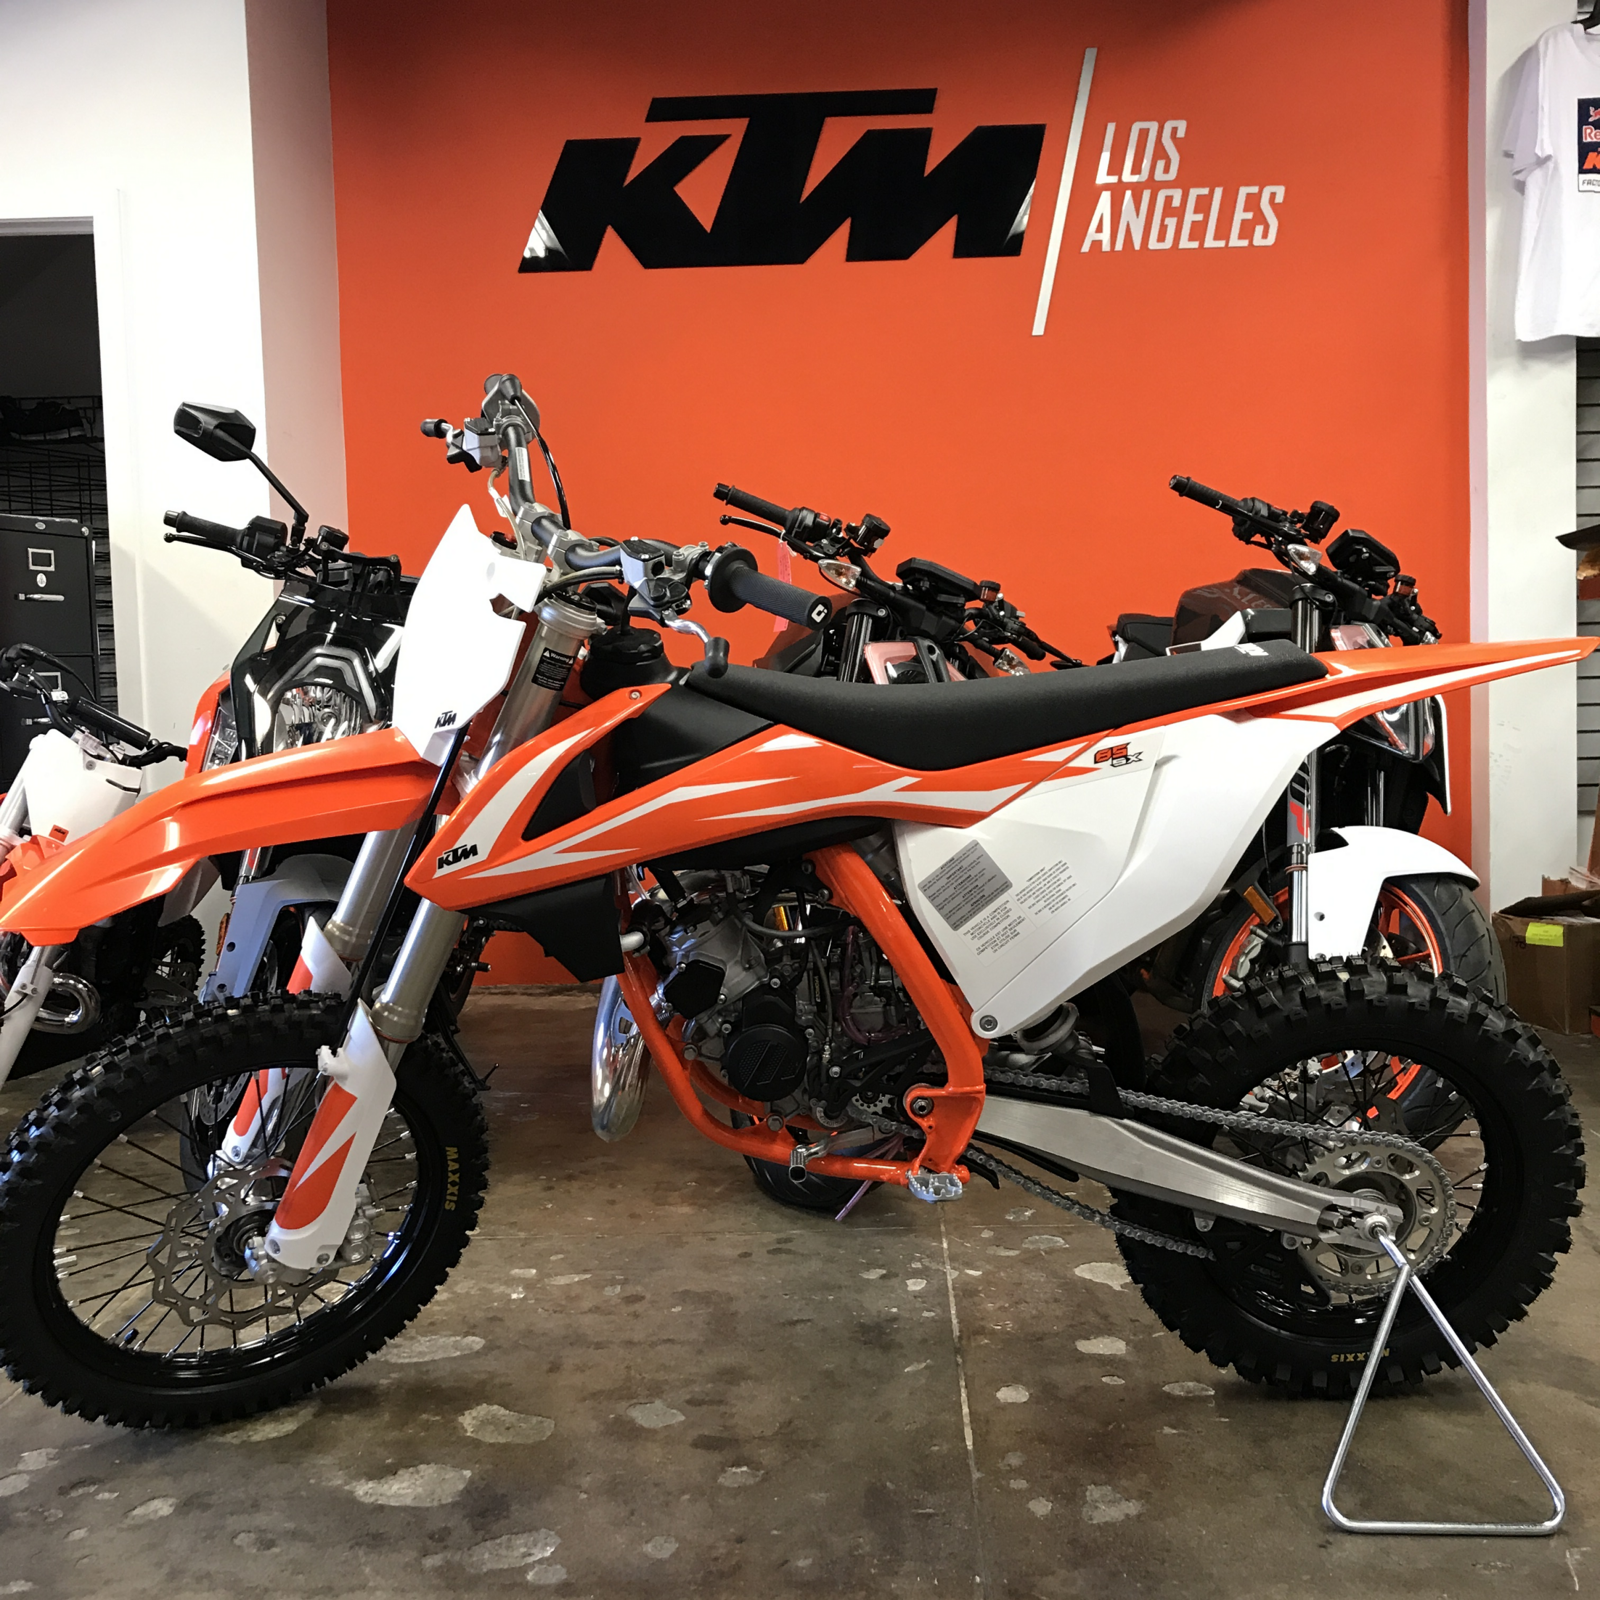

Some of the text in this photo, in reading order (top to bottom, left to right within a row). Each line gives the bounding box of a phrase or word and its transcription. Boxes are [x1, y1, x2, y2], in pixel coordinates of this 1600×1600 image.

[1094, 119, 1188, 186] LOS
[518, 87, 1046, 273] KTM
[1081, 184, 1286, 254] ANGELES
[435, 710, 457, 729] KTM
[1094, 742, 1131, 764] 85
[438, 844, 478, 870] KTM
[445, 1146, 460, 1211] MAXXIS
[1330, 1348, 1390, 1362] MXXIS
